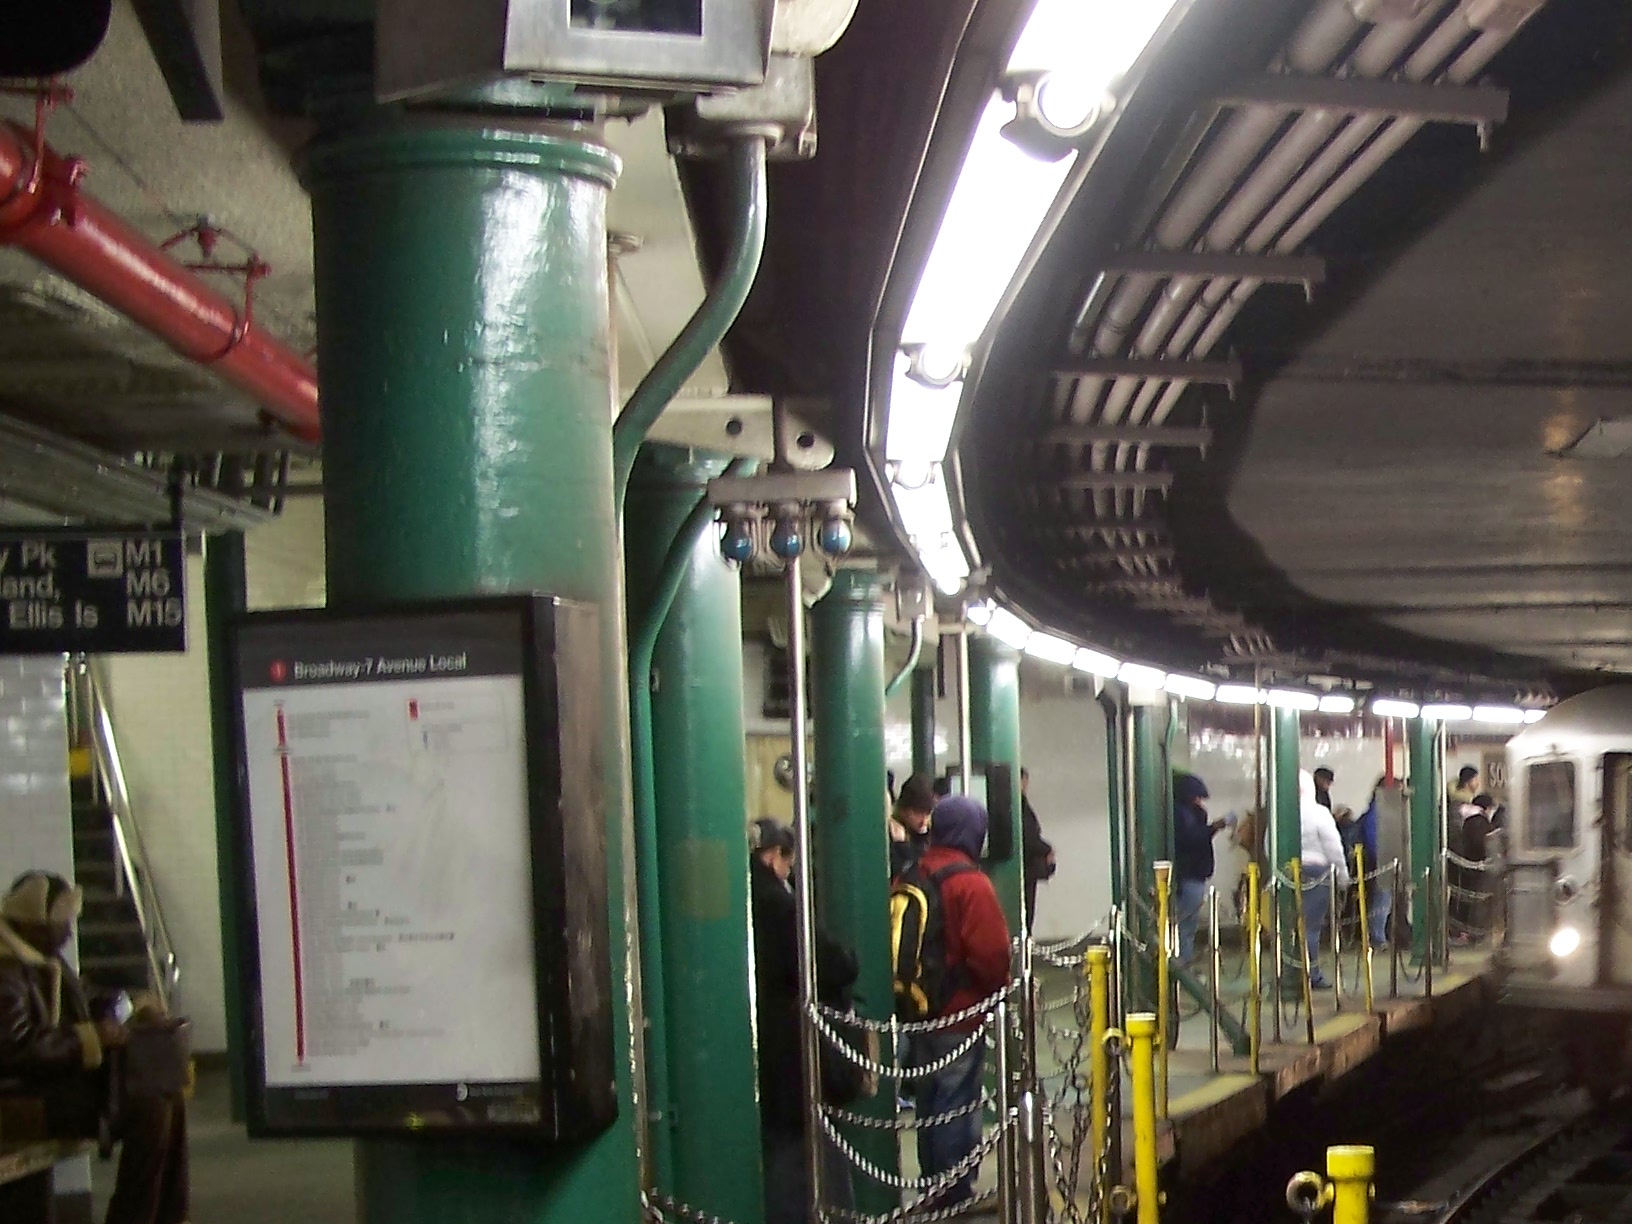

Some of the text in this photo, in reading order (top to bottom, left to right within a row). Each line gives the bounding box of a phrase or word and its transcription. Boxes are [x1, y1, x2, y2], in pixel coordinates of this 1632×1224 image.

[22, 540, 56, 568] Pk
[126, 540, 161, 567] M1
[126, 570, 170, 597] M6
[9, 600, 64, 629] Ellis
[75, 600, 98, 629] Is
[127, 598, 182, 627] M15
[376, 656, 426, 675] Avenue
[430, 651, 467, 672] Local
